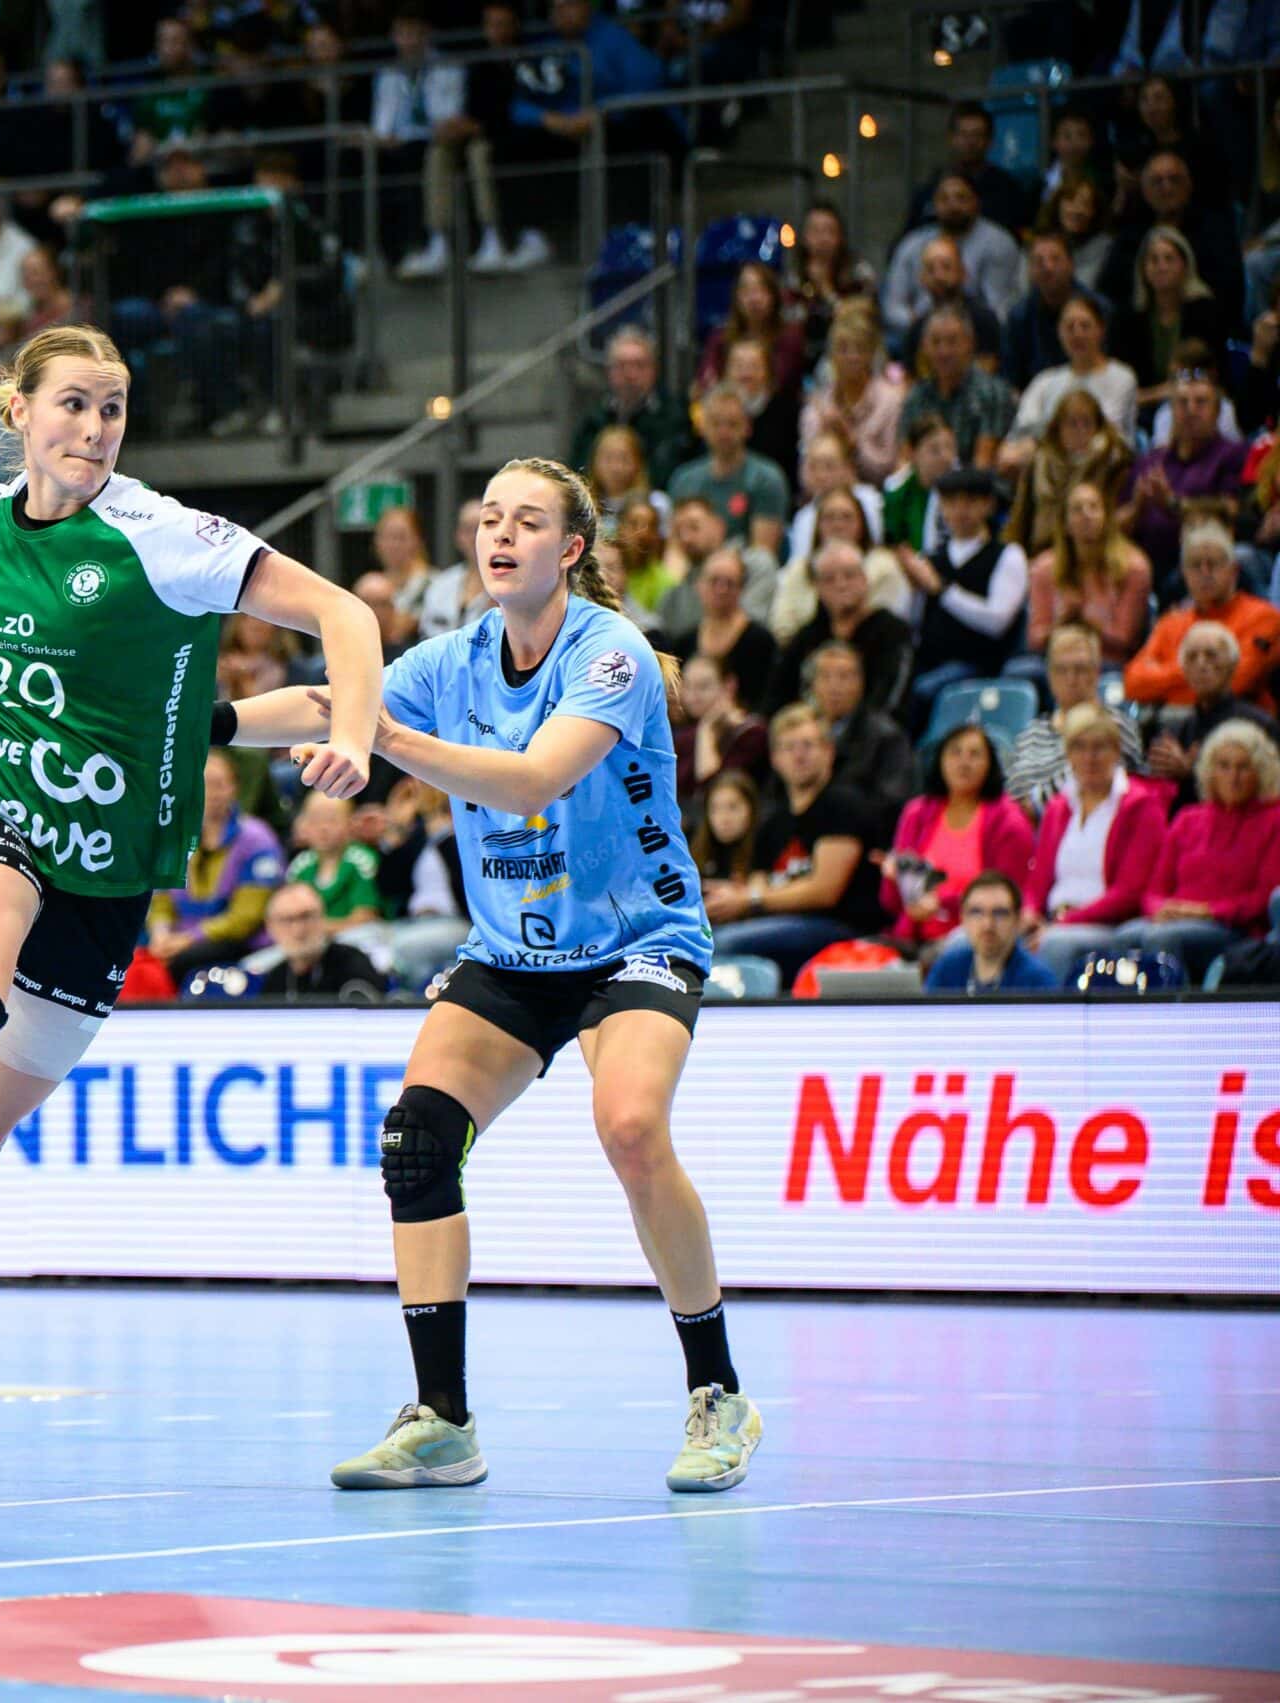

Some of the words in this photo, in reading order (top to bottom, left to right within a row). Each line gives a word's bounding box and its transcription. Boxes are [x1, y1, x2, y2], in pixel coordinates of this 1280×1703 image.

[21, 643, 76, 656] Sparkasse
[159, 643, 193, 789] CleverReach
[14, 968, 42, 991] empa
[51, 987, 87, 1007] Kempa
[785, 1075, 1149, 1206] Nähe
